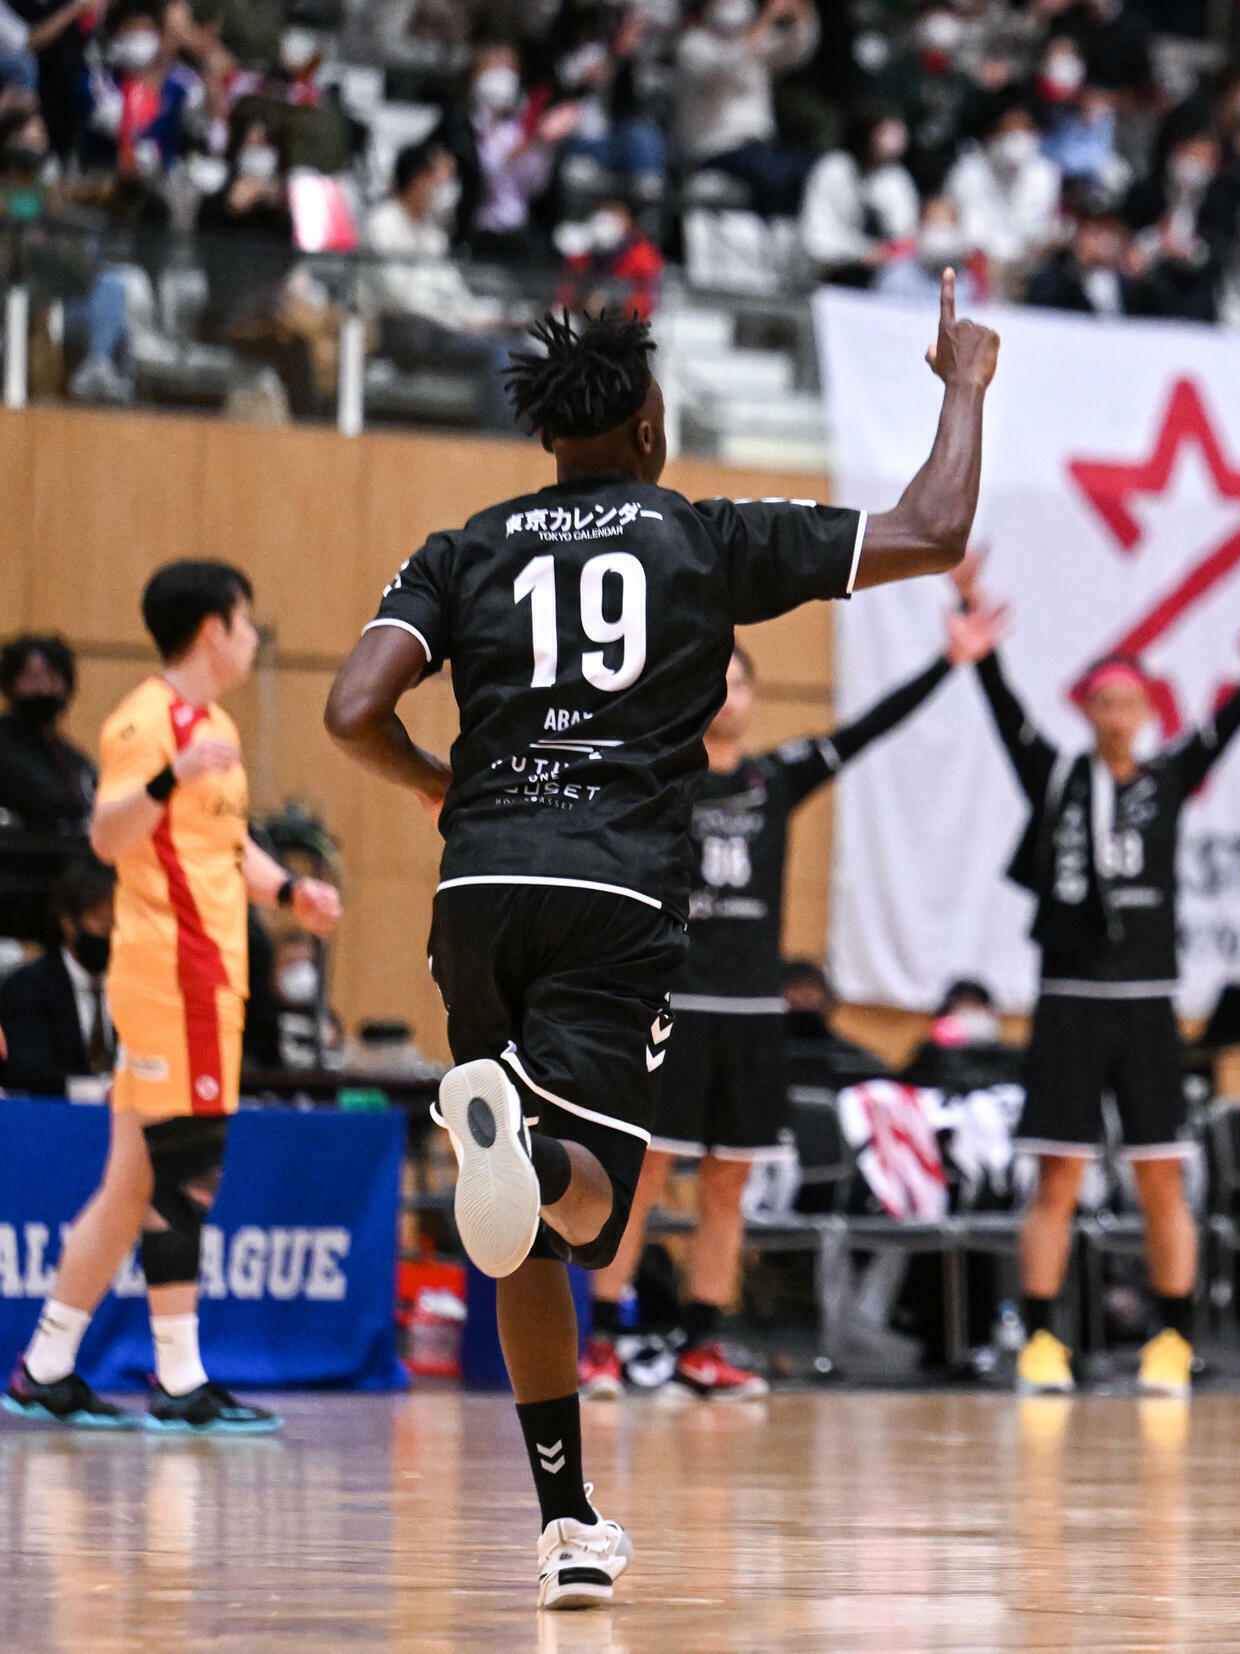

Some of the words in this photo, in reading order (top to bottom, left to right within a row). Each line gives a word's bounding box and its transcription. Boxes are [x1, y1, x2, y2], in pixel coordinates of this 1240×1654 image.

[505, 502, 663, 538] 東京カレンダー
[539, 530, 572, 542] TOKYO
[573, 525, 624, 541] CALENDAR
[513, 551, 647, 692] 19
[112, 1224, 351, 1300] LAGUE
